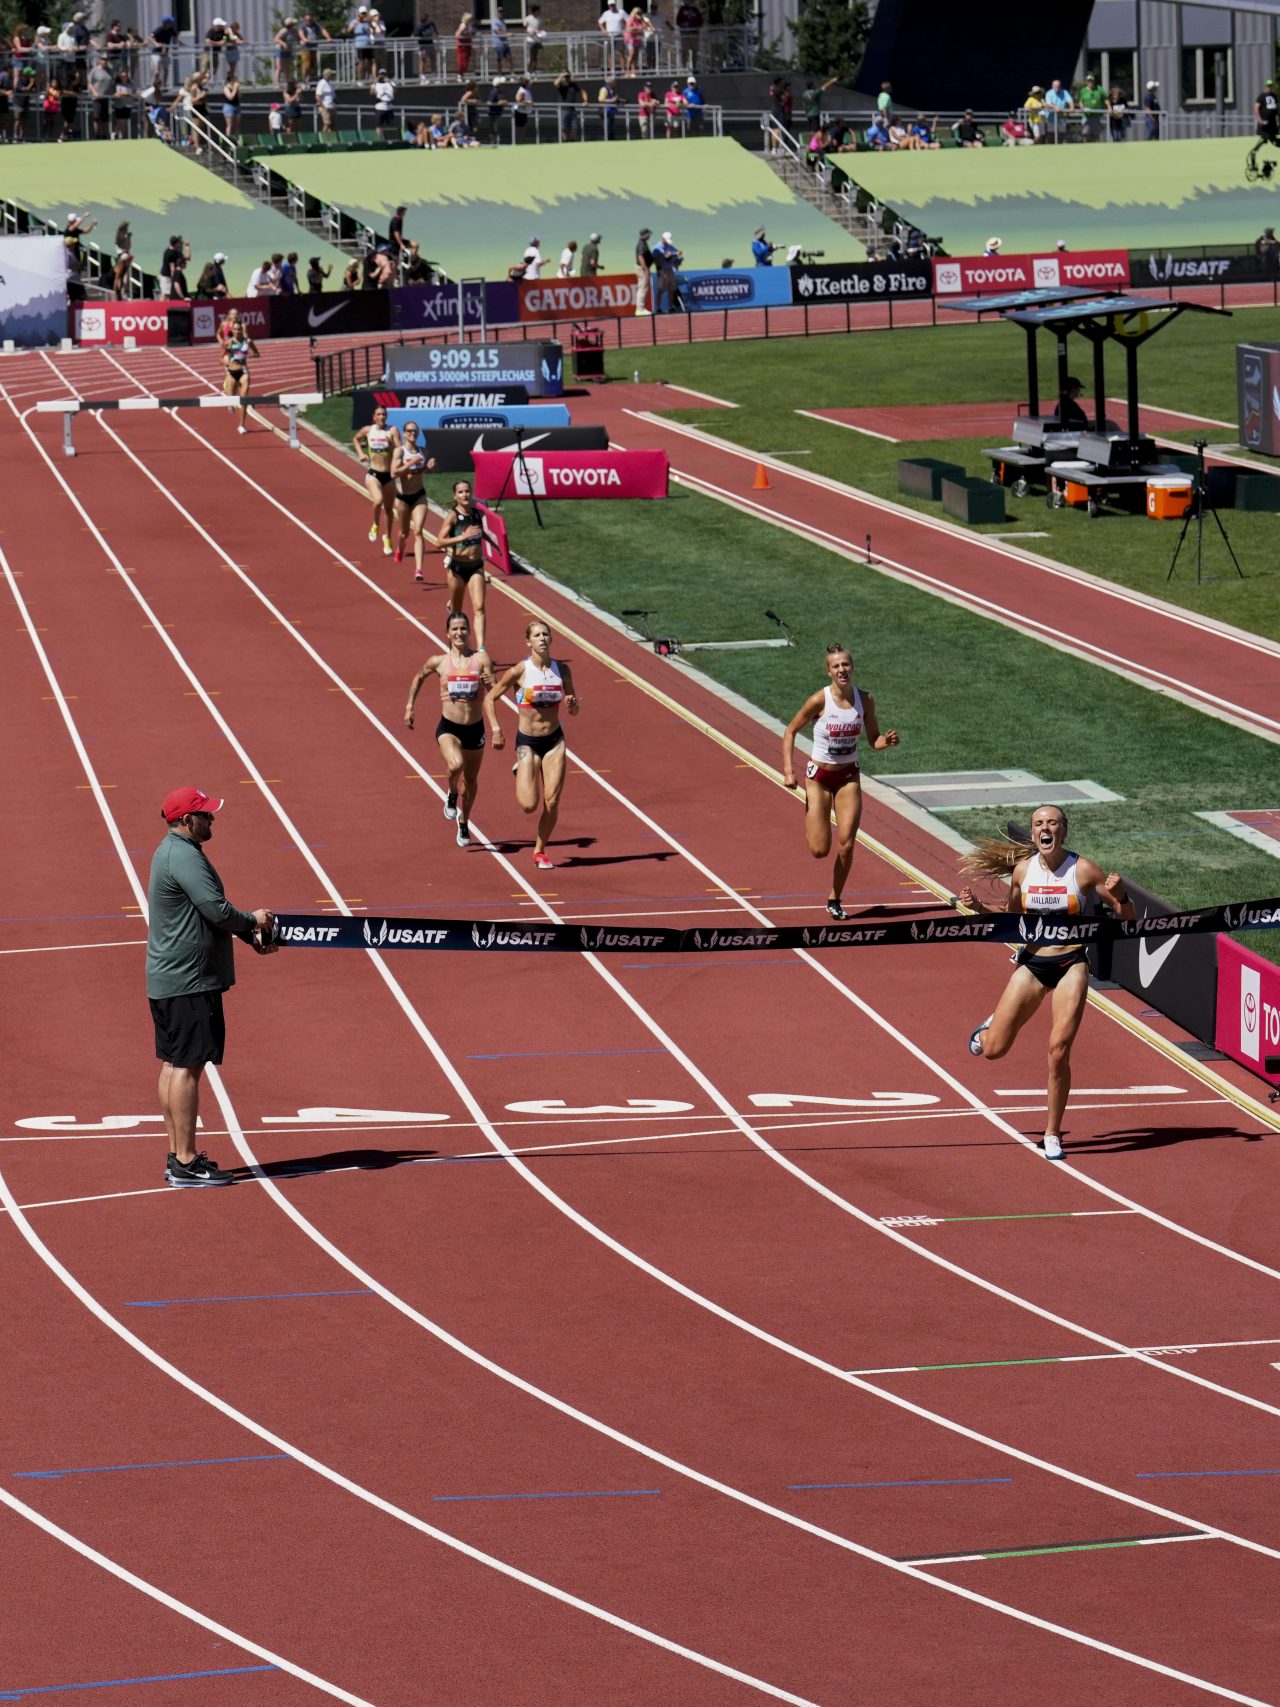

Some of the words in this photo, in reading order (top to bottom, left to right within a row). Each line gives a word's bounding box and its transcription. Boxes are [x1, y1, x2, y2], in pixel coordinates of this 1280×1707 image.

[965, 267, 1026, 284] TOYOTA
[1063, 262, 1126, 279] TOYOTA
[1172, 259, 1230, 277] USATF
[815, 276, 868, 296] Kettle
[869, 274, 886, 293] &
[889, 274, 927, 292] Fire
[423, 291, 484, 320] xfinty
[111, 316, 168, 331] TOYOT
[429, 348, 500, 369] 9:09.15
[394, 370, 437, 383] WOMEN'S
[439, 370, 469, 382] 3000M
[470, 369, 536, 382] STEEPLECHASE
[405, 393, 506, 409] PRIMETIME
[548, 467, 621, 486] TOYOTA
[1148, 492, 1156, 513] G
[825, 722, 862, 731] WOLFPAC
[1031, 896, 1061, 905] HALLADAY
[1144, 914, 1201, 931] USATF
[1247, 907, 1280, 923] USA
[281, 926, 341, 942] USATF
[387, 928, 448, 944] USATF
[826, 929, 887, 943] USATF
[934, 922, 995, 938] USATF
[1043, 923, 1100, 940] USATF
[496, 931, 556, 946] USATF
[604, 932, 665, 947] USATF
[718, 933, 778, 947] USATF
[993, 1085, 1189, 1096] 1
[504, 1098, 695, 1115] 3
[747, 1091, 942, 1108] 2
[14, 1114, 204, 1131] 5
[260, 1106, 451, 1124] 4
